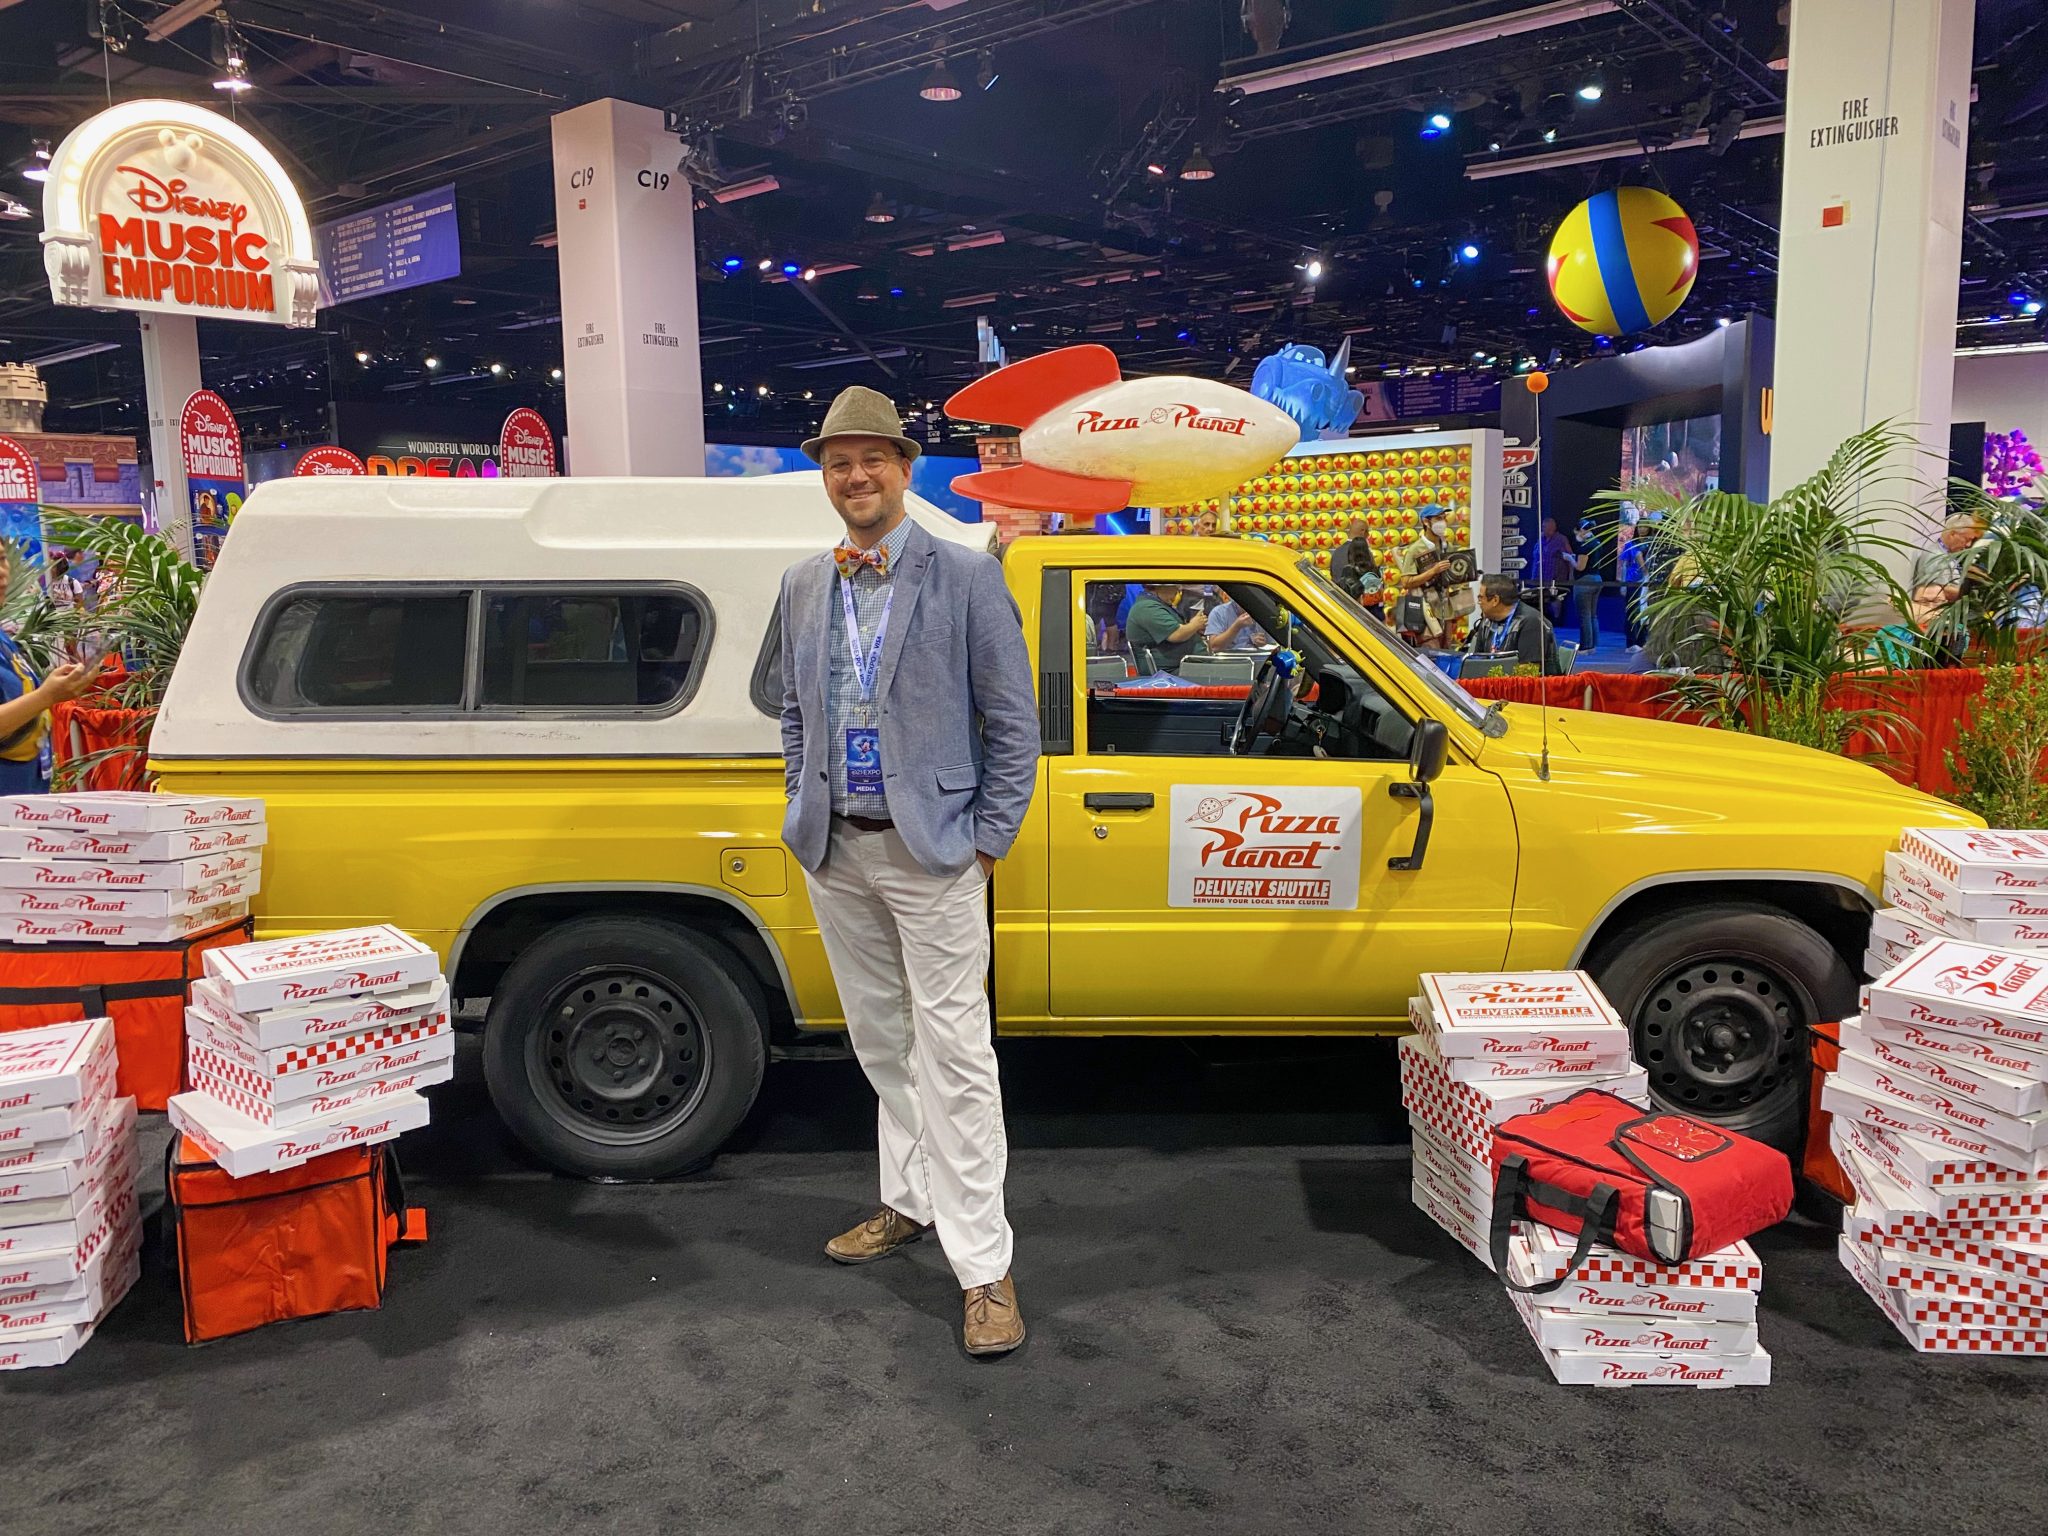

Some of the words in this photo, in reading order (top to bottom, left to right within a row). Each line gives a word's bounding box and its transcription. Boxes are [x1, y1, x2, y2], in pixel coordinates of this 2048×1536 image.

[1842, 97, 1869, 121] FIRE
[1810, 116, 1899, 149] EXTINGUISHER
[571, 166, 594, 189] C19
[637, 169, 670, 191] C19
[99, 212, 271, 272] MUSIC
[104, 254, 277, 314] EMPORIUM
[654, 322, 666, 335] FIRE
[642, 333, 679, 348] EXTINGUISHER
[1072, 409, 1140, 436] Pizza
[1170, 402, 1254, 437] Planet
[187, 433, 236, 458] MUSIC
[407, 440, 460, 456] WONDERFUL
[462, 442, 490, 456] WORLD
[491, 444, 501, 456] O
[507, 446, 550, 467] MUSIC
[189, 453, 238, 477] EMPORIUM
[1503, 488, 1527, 505] AD
[13, 803, 50, 822] Pizza
[62, 805, 113, 825] Planet
[184, 809, 210, 826] Pizza
[219, 806, 255, 822] Planet
[1228, 791, 1341, 834] Pizza
[23, 835, 65, 853] Pizza
[79, 836, 133, 855] Planet
[189, 835, 213, 852] Pizza
[221, 831, 251, 847] Planet
[1189, 826, 1336, 870] Planet
[31, 866, 76, 884] Pizza
[95, 867, 148, 885] Planet
[1994, 870, 2038, 888] Pizza
[1194, 879, 1263, 897] DELIVERY
[1267, 879, 1331, 898] SHUTTLE
[17, 892, 59, 911] Pizza
[75, 894, 129, 912] Planet
[13, 918, 57, 936] Pizza
[73, 918, 129, 937] Planet
[1904, 926, 1926, 946] Piz
[253, 957, 328, 973] DELIVERY
[277, 982, 329, 1001] Pizza
[344, 970, 403, 990] Planet
[1487, 981, 1577, 993] Pizza
[301, 1017, 347, 1036] Pizza
[355, 1005, 415, 1021] Planet
[1459, 1008, 1525, 1016] DELIVERY
[1528, 1007, 1589, 1016] SHUTTLE
[1904, 1001, 1960, 1027] Pizza
[1976, 1014, 2046, 1044] Planet
[1480, 1037, 1523, 1053] Pizza
[1538, 1036, 1592, 1052] Planet
[1899, 1024, 1951, 1053] Pizza
[1966, 1041, 2034, 1074] Planet
[313, 1070, 356, 1088] Pizza
[373, 1050, 423, 1070] Planet
[1489, 1061, 1530, 1077] Pizza
[1545, 1058, 1596, 1073] Planet
[1870, 1037, 1912, 1070] Pizza
[1925, 1059, 1982, 1096] Planet
[0, 1092, 33, 1109] net
[312, 1095, 351, 1115] Pizza
[368, 1075, 418, 1097] Planet
[1872, 1070, 1915, 1102] Pizza
[1931, 1092, 1991, 1130] Planet
[1861, 1101, 1910, 1133] Pizza
[1927, 1121, 1992, 1156] Planet
[273, 1142, 321, 1161] Pizza
[337, 1120, 393, 1142] Planet
[1, 1271, 32, 1285] net
[1574, 1285, 1626, 1308] Pizza
[1645, 1289, 1707, 1314] Planet
[1581, 1327, 1631, 1348] Pizza
[1650, 1331, 1711, 1352] Planet
[1599, 1361, 1650, 1381] Pizza
[1666, 1361, 1727, 1381] Planet
